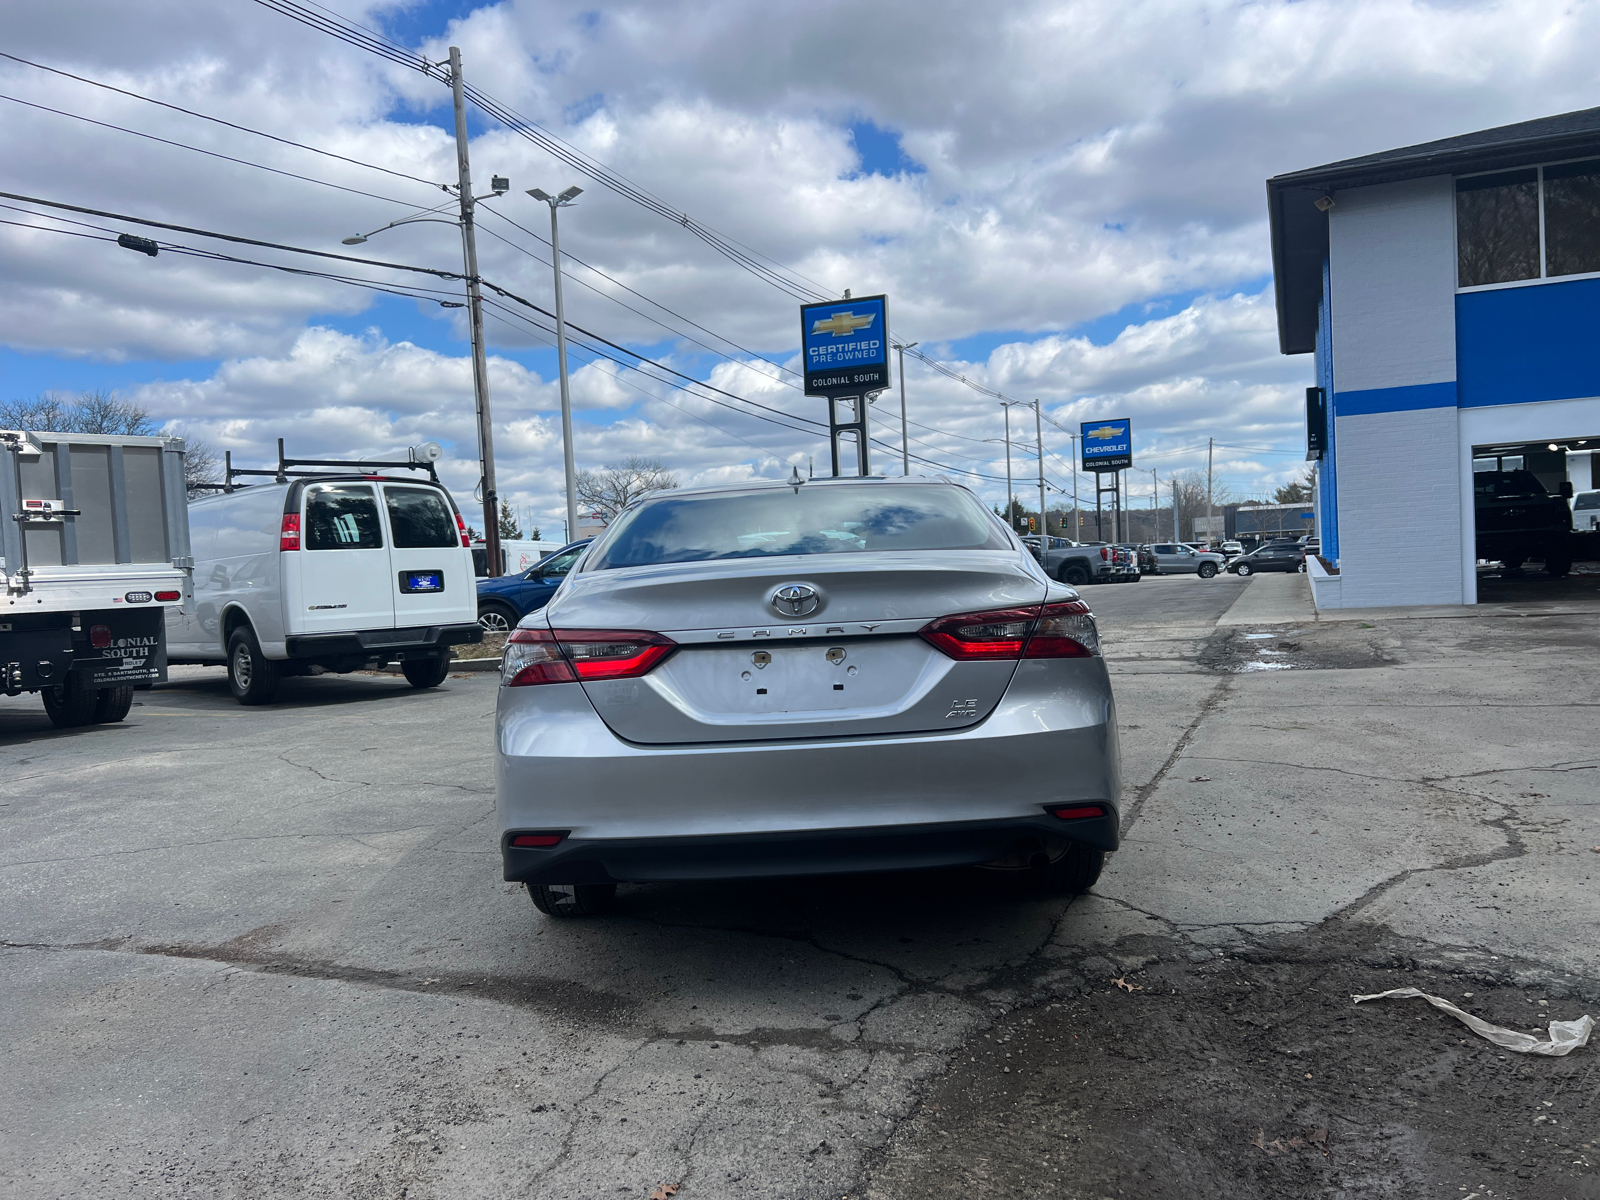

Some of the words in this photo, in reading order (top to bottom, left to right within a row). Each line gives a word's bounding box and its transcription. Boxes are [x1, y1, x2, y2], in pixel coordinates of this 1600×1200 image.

[809, 340, 880, 356] CERTIFIED
[813, 349, 877, 363] PRE-OWNED
[812, 376, 850, 387] COLONIAL
[854, 373, 879, 383] SOUTH
[1085, 444, 1127, 454] CHEVROLET
[717, 623, 882, 639] CAMRY
[93, 636, 158, 649] LONIAL
[102, 647, 149, 659] SOUTH
[951, 698, 978, 709] LE
[945, 709, 977, 719] AWD
